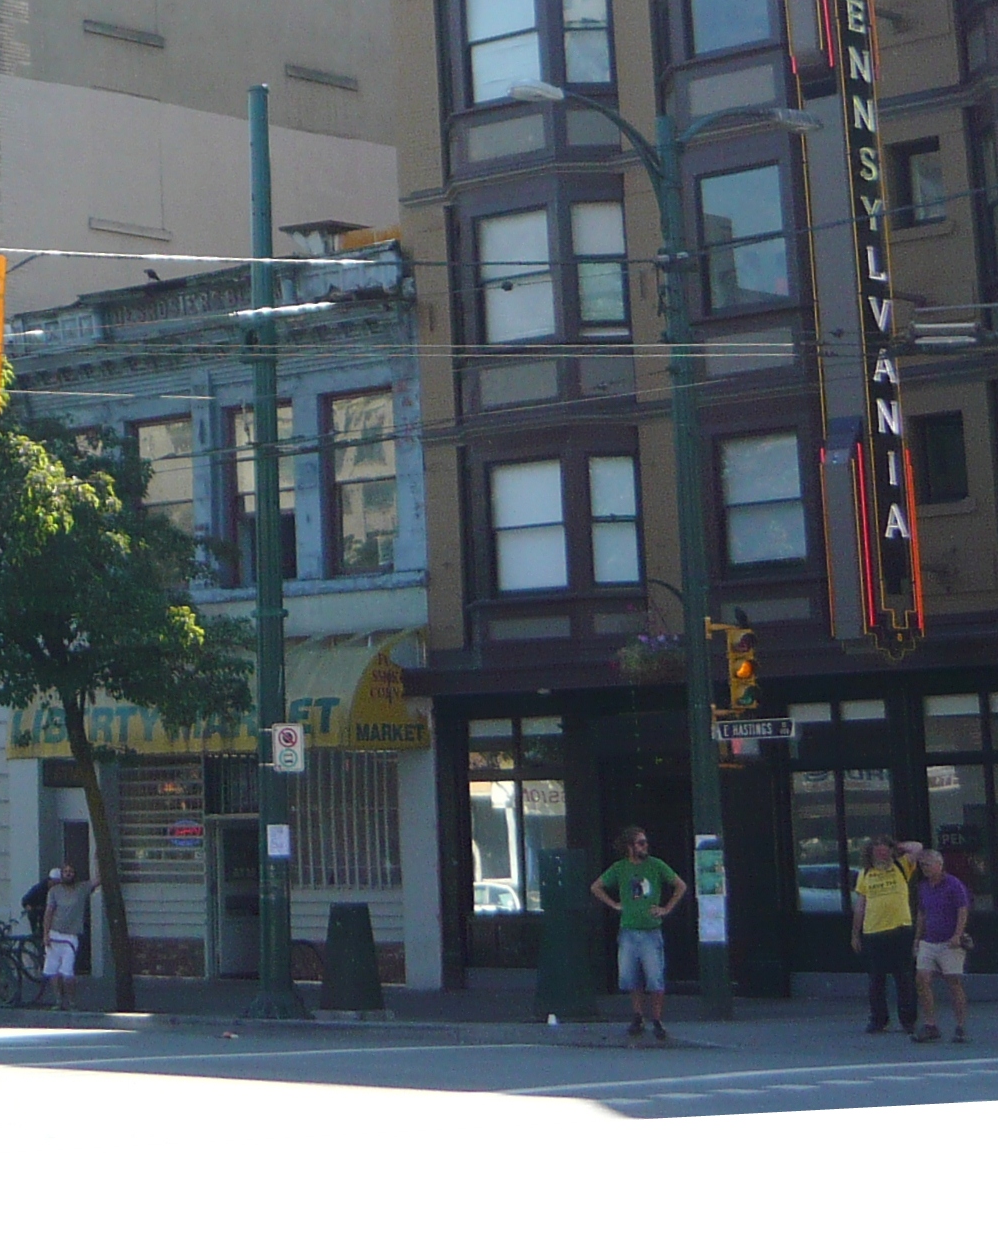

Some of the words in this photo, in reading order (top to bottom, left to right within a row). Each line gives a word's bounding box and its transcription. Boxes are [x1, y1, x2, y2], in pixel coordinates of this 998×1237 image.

[10, 704, 162, 745] LIBRTY
[355, 722, 425, 742] MARKET
[723, 724, 729, 737] E
[732, 722, 773, 736] HASTINGS
